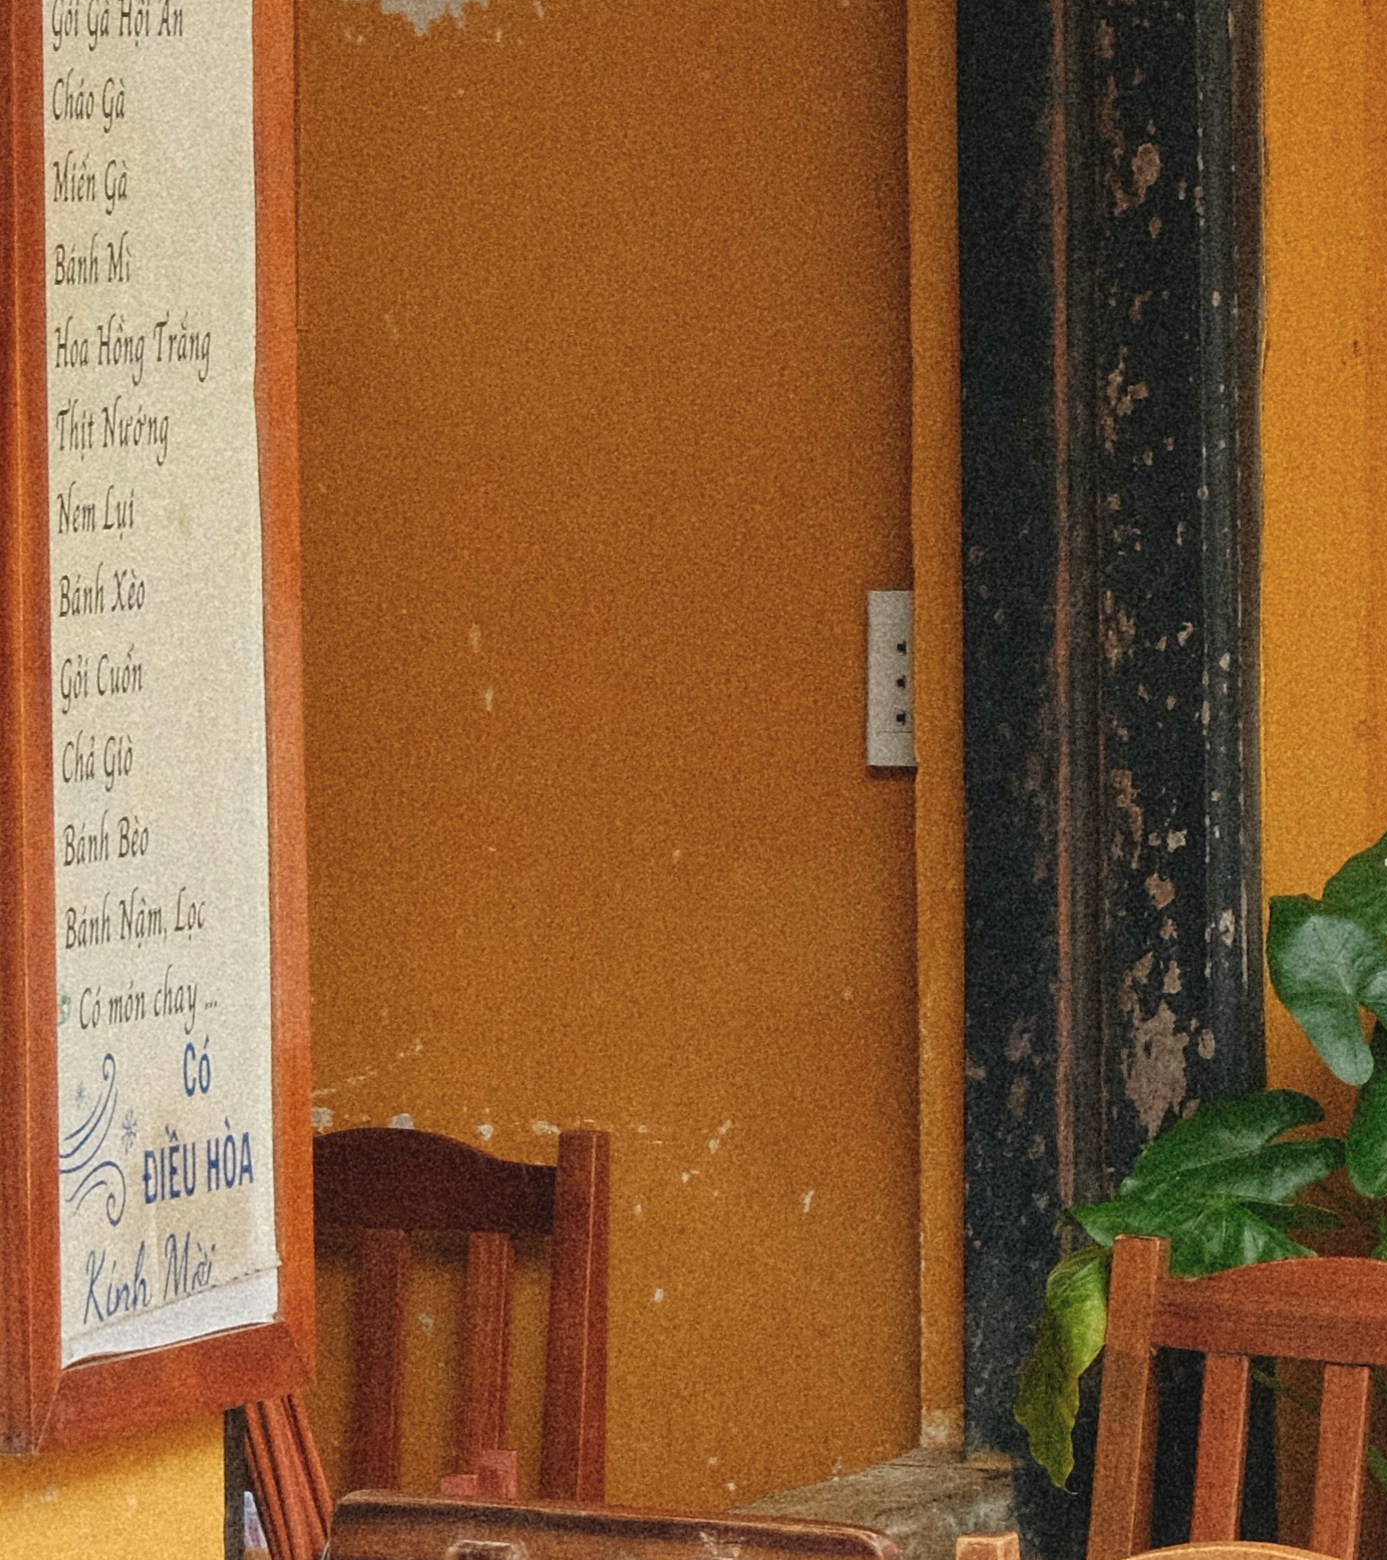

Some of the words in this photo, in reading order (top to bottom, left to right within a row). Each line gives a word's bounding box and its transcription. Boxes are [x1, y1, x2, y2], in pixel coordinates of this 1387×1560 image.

[52, 67, 95, 122] Cháo
[102, 76, 126, 134] Gà
[105, 158, 128, 216] Gà
[54, 232, 100, 286] Bánh
[54, 315, 89, 369] Hoa
[56, 398, 96, 461] Thịt
[101, 395, 171, 467] Nướng
[57, 481, 97, 535] Nem
[58, 561, 106, 618] Bánh
[111, 567, 147, 615] Xèo
[63, 807, 110, 867] Bánh
[117, 816, 150, 861] Bèo
[64, 887, 112, 950] Bánh
[174, 885, 207, 942] Lọc
[79, 985, 102, 1030] Có
[109, 980, 146, 1025] món
[183, 1033, 212, 1097] Có
[206, 1116, 254, 1191] HÒA
